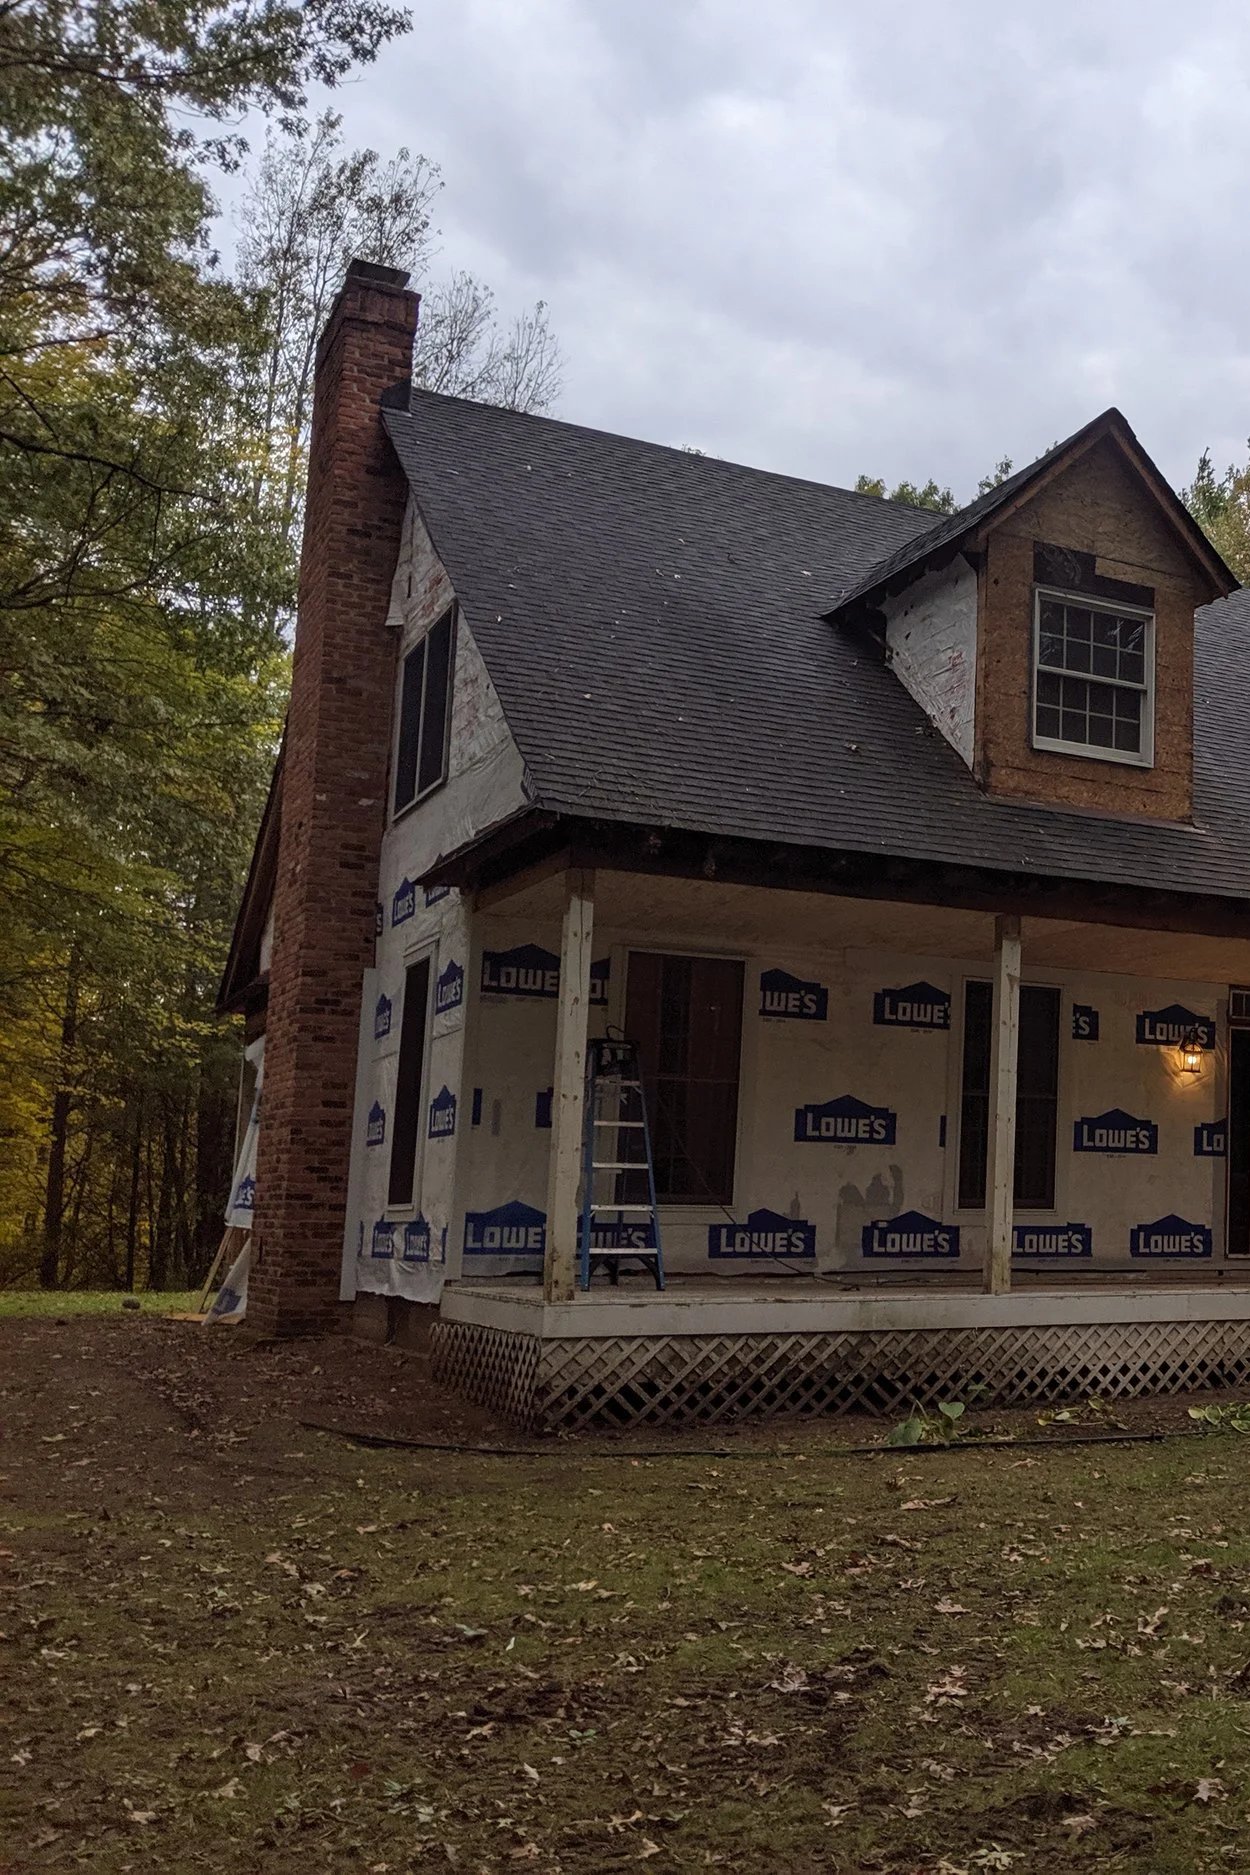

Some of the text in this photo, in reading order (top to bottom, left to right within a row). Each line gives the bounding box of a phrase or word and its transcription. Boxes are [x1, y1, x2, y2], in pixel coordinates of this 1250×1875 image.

[760, 990, 817, 1014] WE'S
[806, 1112, 886, 1140] LOWE'S
[1082, 1124, 1151, 1150] LOWE'S
[719, 1228, 806, 1253] LOWE'S
[872, 1229, 950, 1253] LOWE'S
[1012, 1230, 1083, 1254] LOWE'S
[1138, 1231, 1204, 1254] LOWE'S
